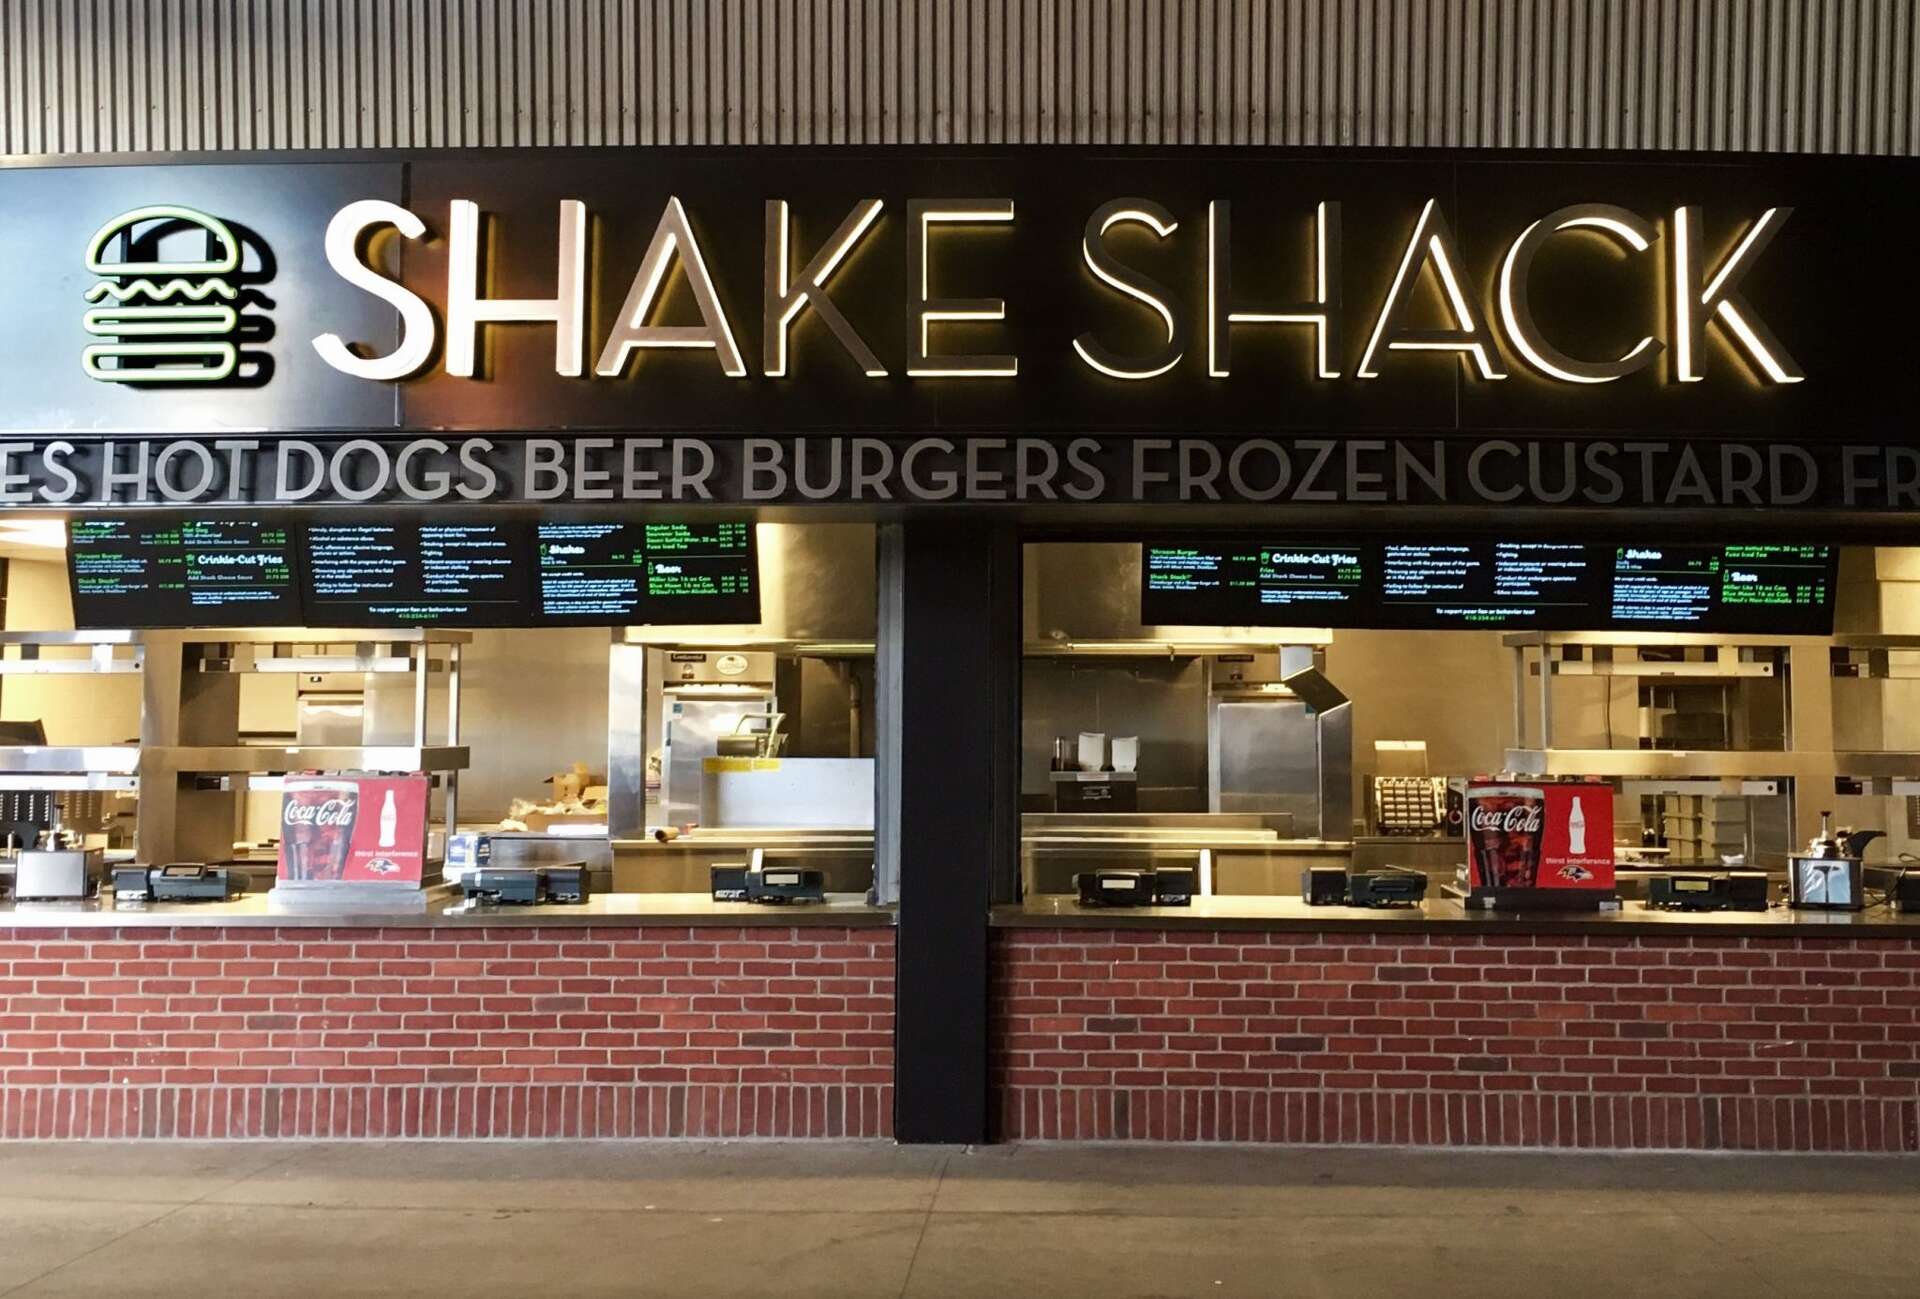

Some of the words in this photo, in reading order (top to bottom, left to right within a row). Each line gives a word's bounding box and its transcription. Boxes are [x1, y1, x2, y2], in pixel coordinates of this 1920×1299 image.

[311, 195, 1018, 381] SHAKE
[1072, 195, 1805, 384] SHACK
[0, 440, 78, 502] ES
[103, 439, 260, 501] HOT
[276, 438, 498, 500] DOGS
[524, 437, 715, 500] BEER
[742, 437, 1106, 500] BURGERS
[1132, 438, 1447, 501] FROZEN
[1468, 440, 1819, 504] CUSTARD
[1842, 446, 1920, 507] FR
[548, 544, 585, 554] Shakes
[1272, 552, 1330, 564] Crinkle-Cut
[1331, 554, 1357, 566] Fries
[1625, 549, 1662, 559] Shakes
[198, 554, 256, 564] Crinkle-Cut
[256, 554, 283, 566] Fries
[284, 798, 356, 826] Coca-Cola
[1472, 804, 1543, 832] Coca-Cola
